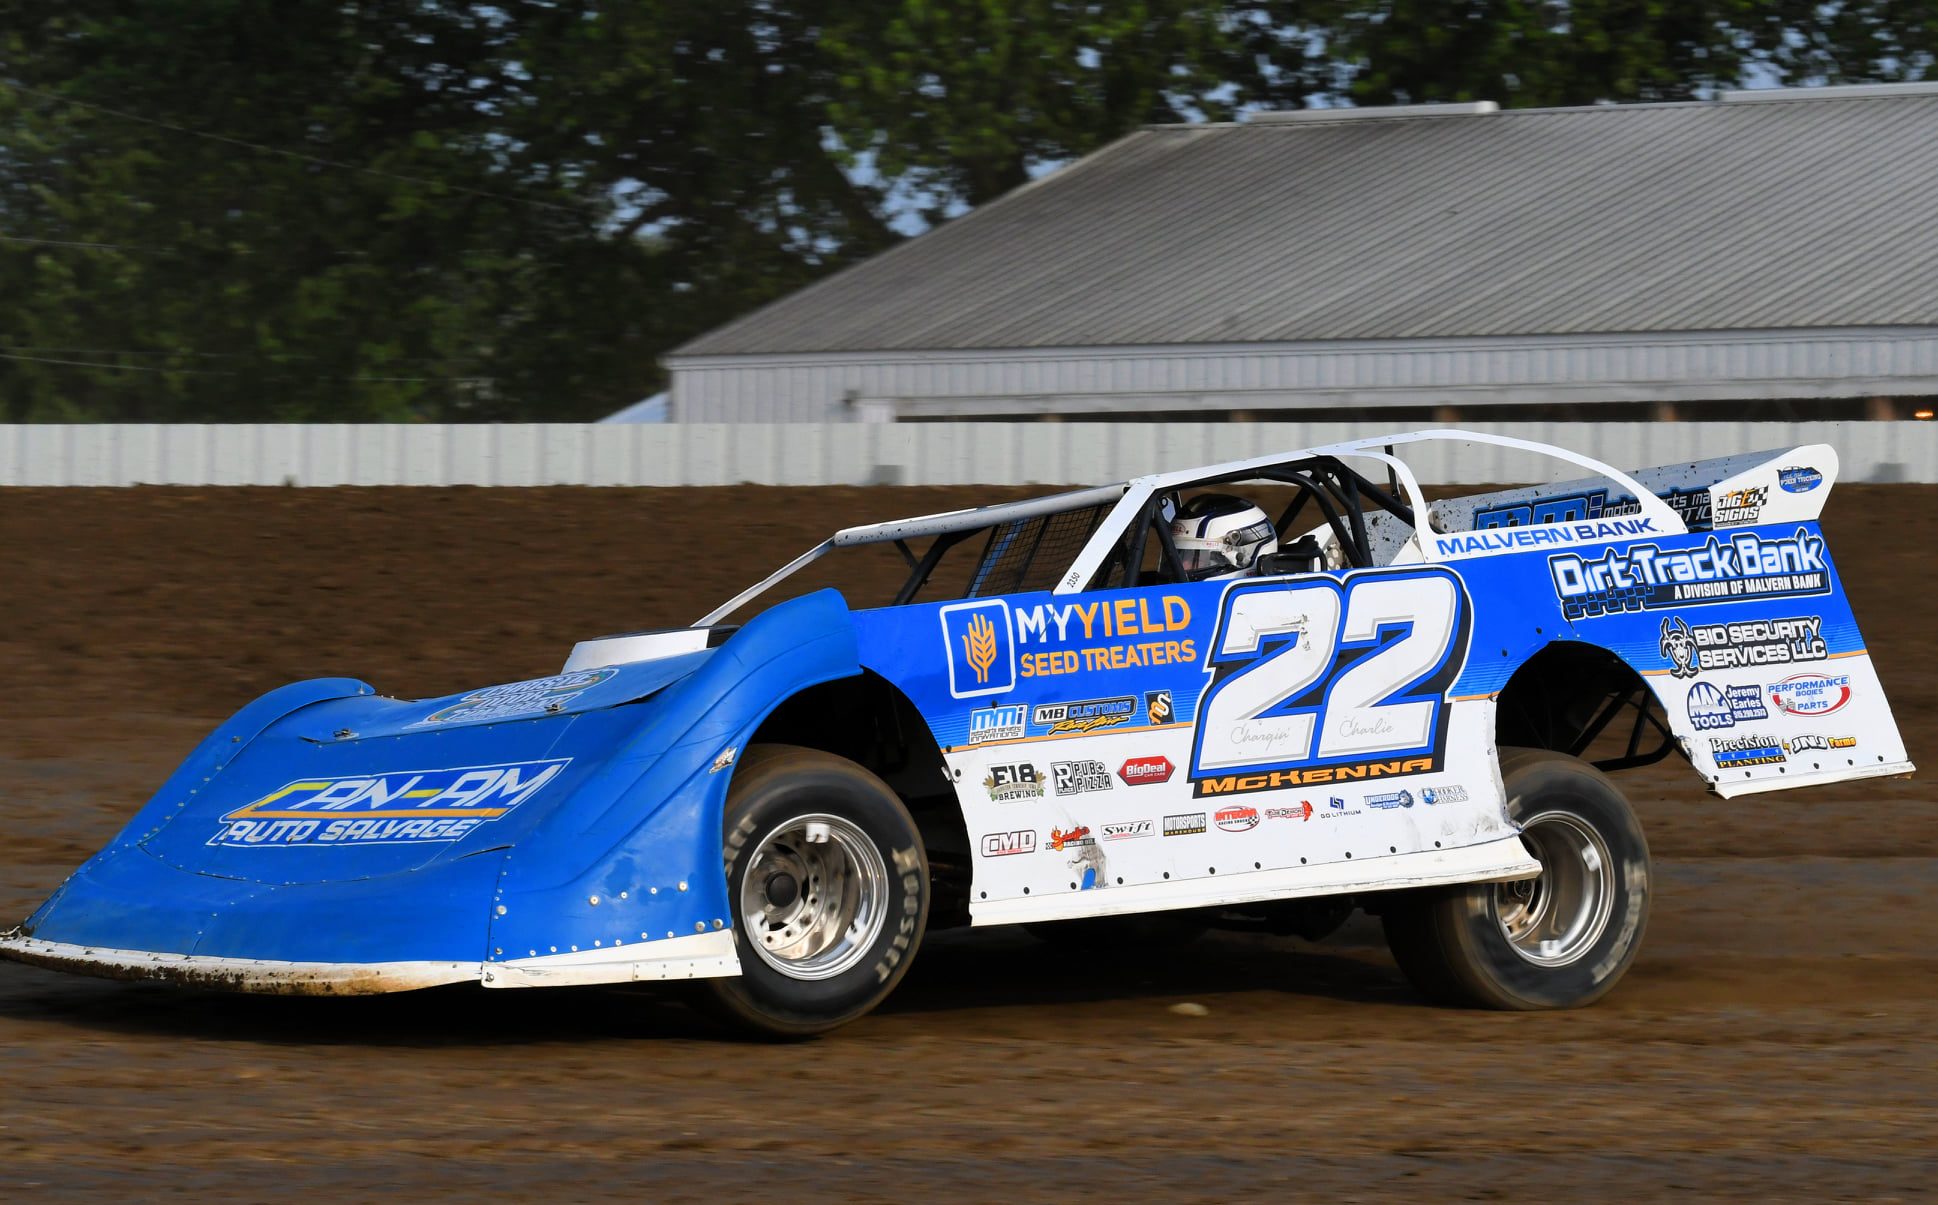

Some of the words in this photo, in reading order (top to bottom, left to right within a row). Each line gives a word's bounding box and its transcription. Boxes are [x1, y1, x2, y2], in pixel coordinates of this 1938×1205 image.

[1714, 506, 1760, 522] SIGNS
[1436, 526, 1574, 556] MALVERN
[1574, 517, 1658, 540] BANK
[1552, 552, 1634, 597] Dirt
[1632, 540, 1737, 585] Track
[1735, 532, 1825, 577] Bank
[1674, 586, 1683, 600] A
[1684, 583, 1728, 599] DIVISION
[1731, 582, 1744, 594] OF
[1746, 578, 1792, 594] MALVERN
[1792, 573, 1822, 588] BANK
[1694, 627, 1728, 646] BIO
[1729, 619, 1820, 643] SECURITY
[1020, 650, 1080, 677] SEED
[1081, 639, 1197, 671] TREATERS
[1700, 645, 1788, 669] SERVICES
[1790, 641, 1827, 661] LLC
[1199, 576, 1458, 772] 22
[1727, 687, 1760, 698] Jeremy
[1768, 676, 1849, 693] PERFORMANCE
[1795, 688, 1824, 697] BODIES
[1039, 708, 1065, 721] MB
[1069, 701, 1131, 717] CUSTOMS
[1732, 699, 1761, 709] Earles
[1797, 700, 1828, 711] PARTS
[1339, 717, 1394, 738] Charlie
[1692, 714, 1734, 728] TOOLS
[1711, 735, 1778, 752] Precision
[1793, 736, 1827, 753] JNJ
[1828, 737, 1857, 748] Farms
[1074, 763, 1096, 776] PUB
[1126, 761, 1166, 777] BigDeal
[1718, 756, 1786, 769] PLANTING
[991, 764, 1037, 788] E18
[1077, 775, 1112, 792] PIZZA
[999, 791, 1037, 801] BREWING
[1332, 810, 1361, 818] LITHIUM
[223, 820, 316, 842] AUTO
[317, 819, 479, 841] SALVAGE
[1103, 821, 1151, 836] Swift
[1164, 815, 1205, 831] MOTORSPORTS
